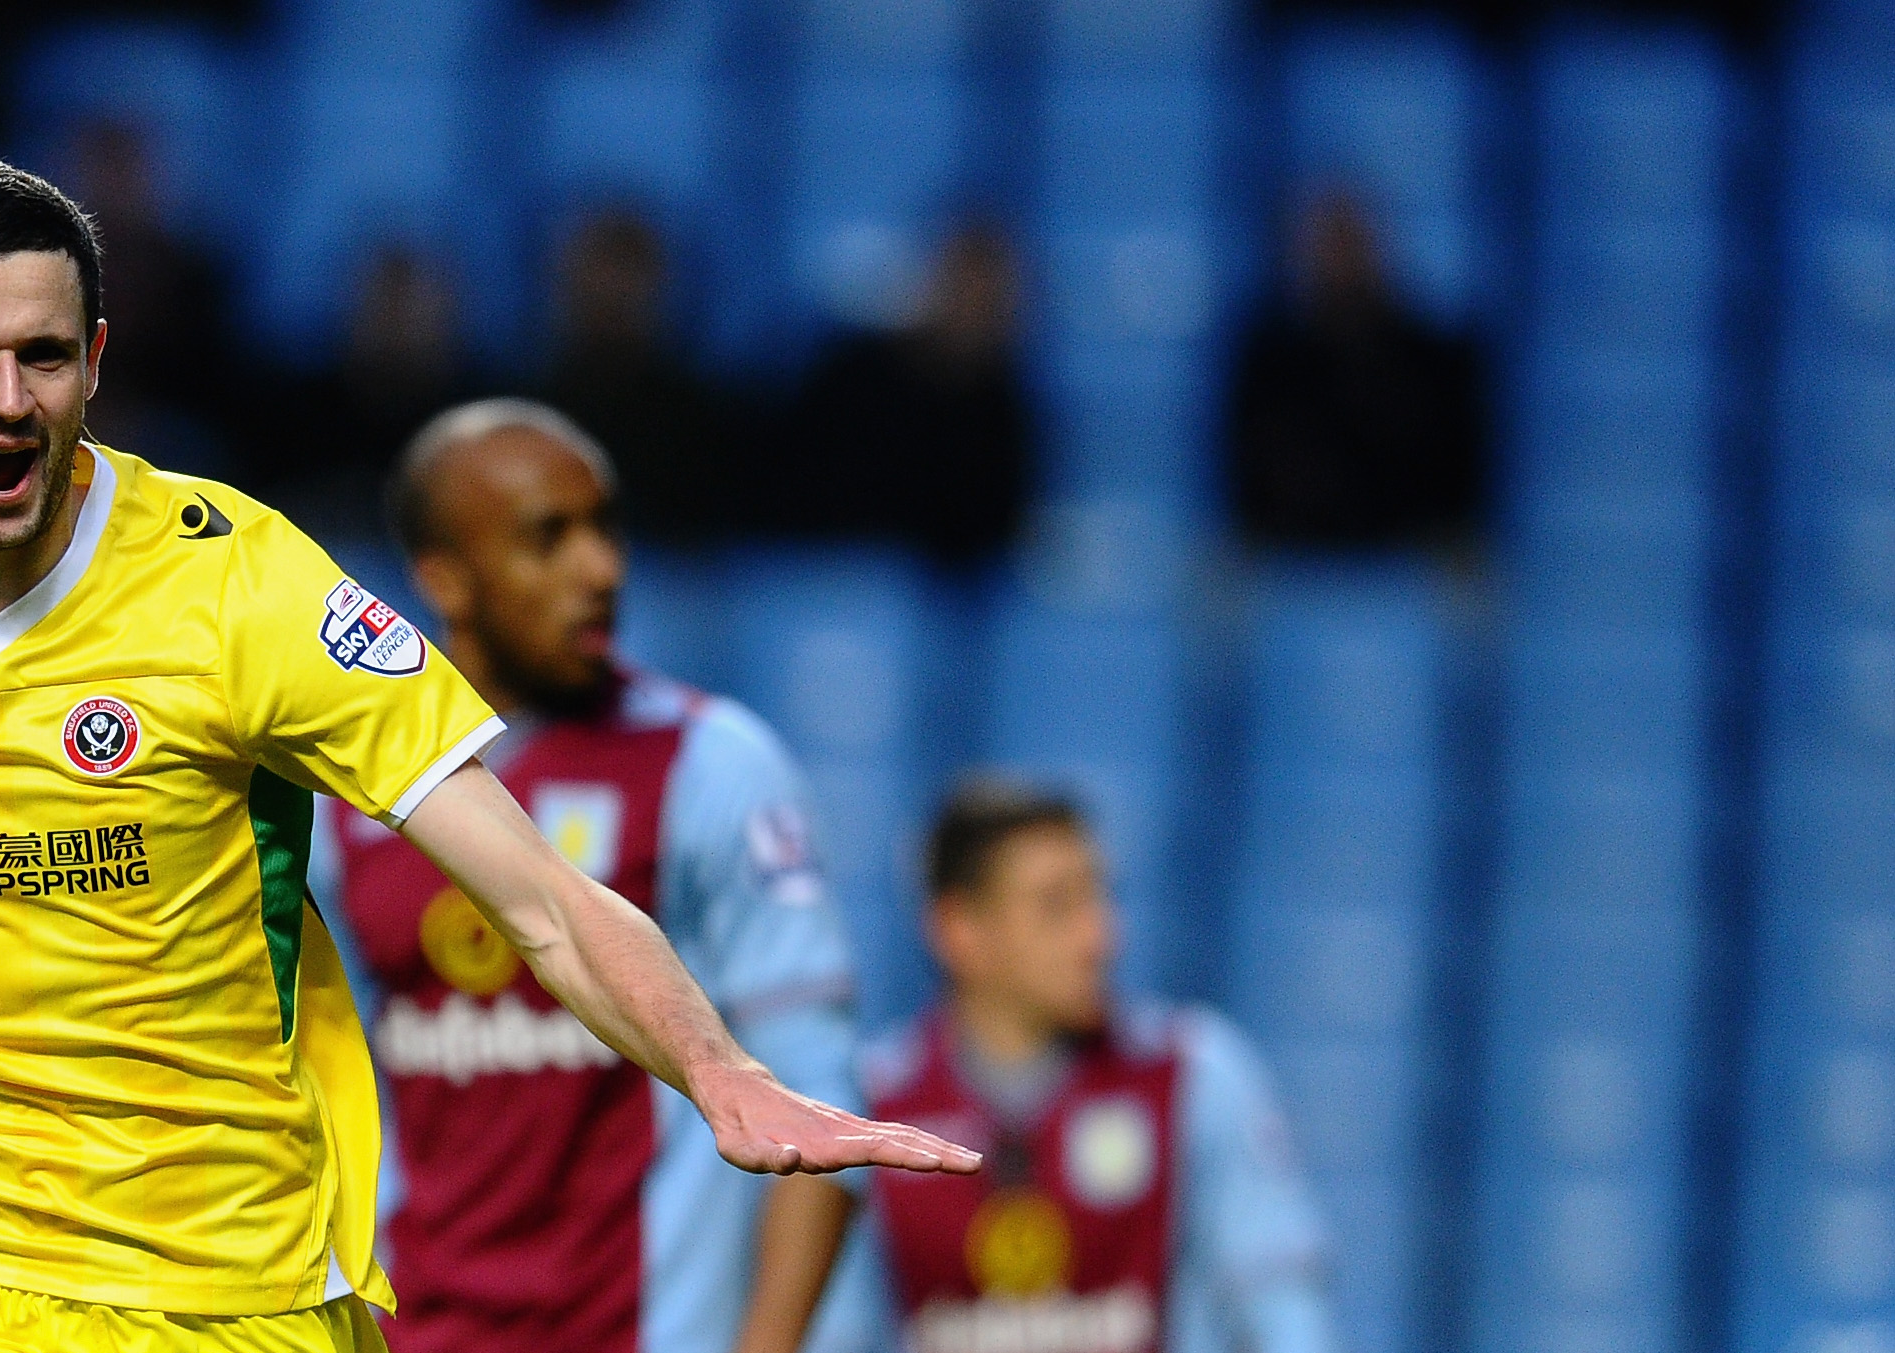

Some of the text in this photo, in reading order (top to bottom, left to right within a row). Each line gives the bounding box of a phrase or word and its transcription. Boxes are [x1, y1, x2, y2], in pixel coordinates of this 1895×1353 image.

[336, 601, 396, 663] sky BE
[372, 623, 407, 659] FOOTBALL
[377, 626, 414, 667] LEAGUE
[98, 701, 129, 719] UNITED
